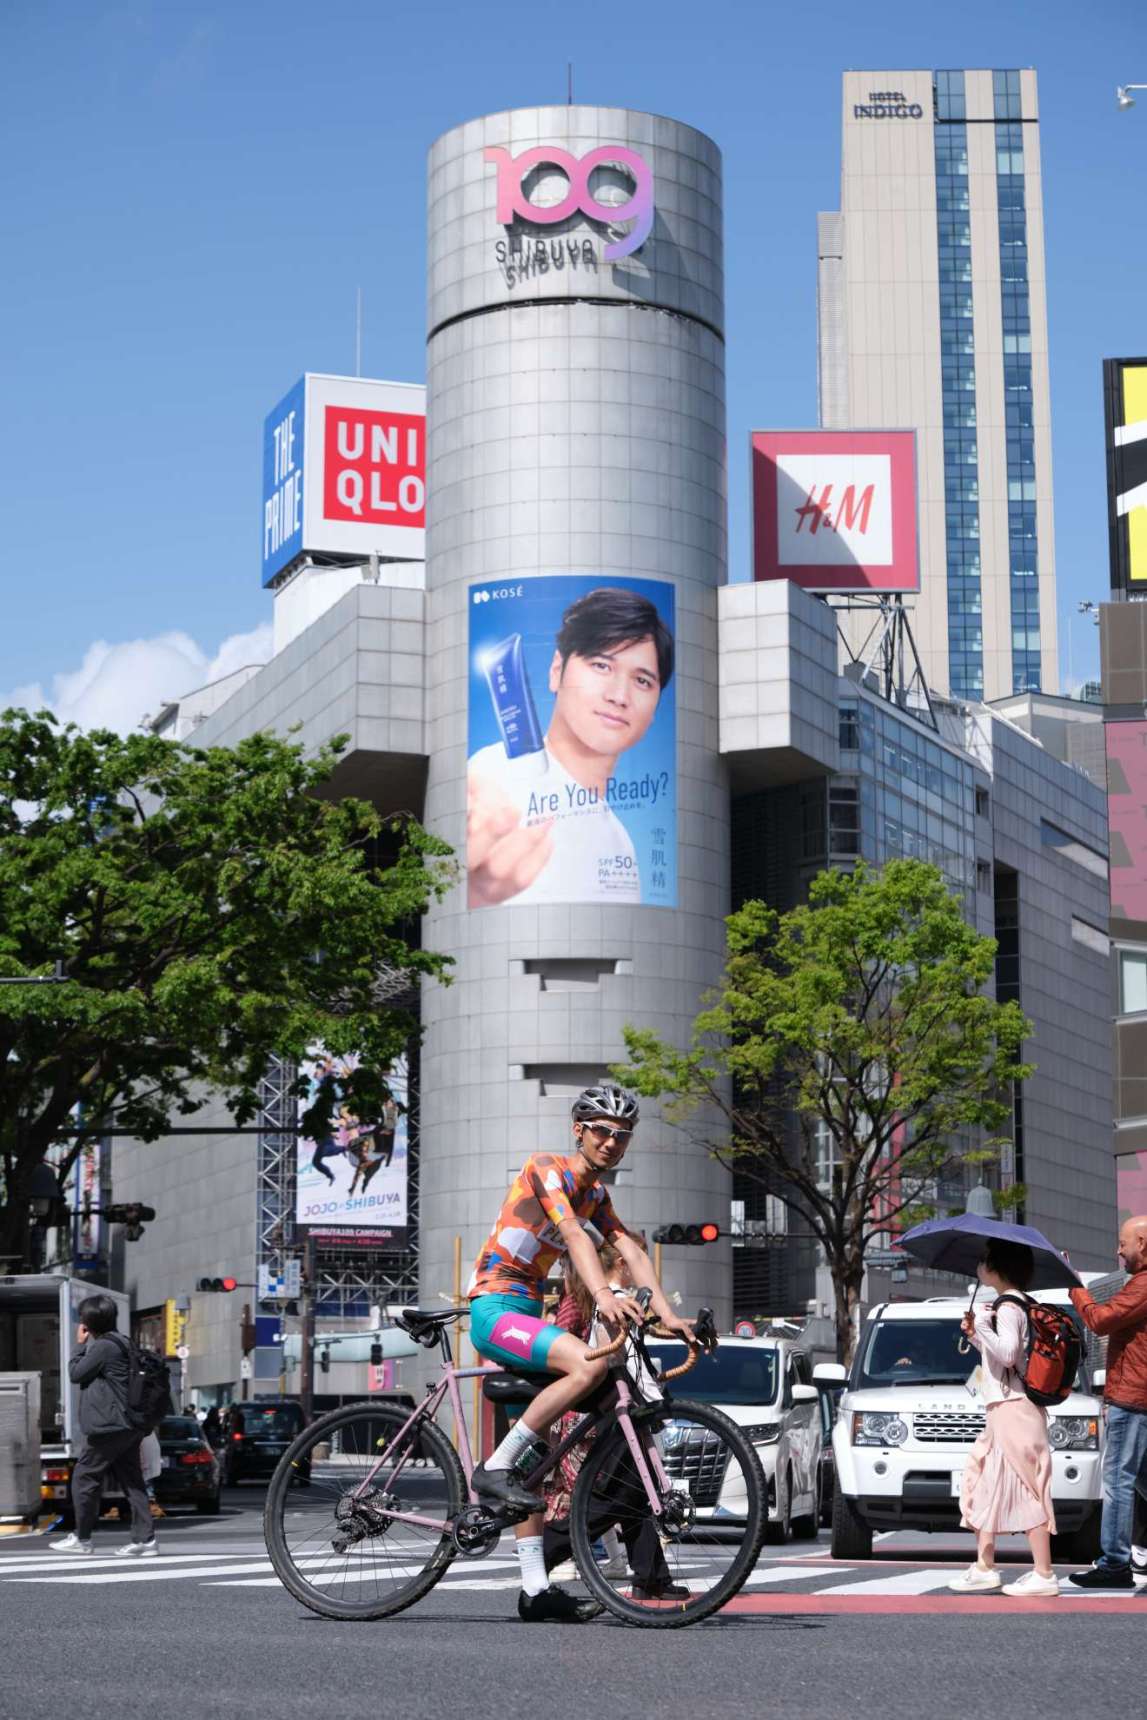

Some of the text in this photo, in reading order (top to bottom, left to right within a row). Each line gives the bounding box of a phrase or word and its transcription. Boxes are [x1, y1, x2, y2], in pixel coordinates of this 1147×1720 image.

[854, 103, 923, 119] INDIGO
[868, 91, 906, 102] HOTEL
[483, 145, 655, 261] 109
[495, 239, 593, 264] SHIBUYA
[274, 410, 296, 486] THE
[337, 421, 417, 467] UNI
[264, 469, 302, 560] PRIME
[336, 469, 426, 515] QLO
[795, 484, 875, 535] H&M
[492, 585, 524, 600] KOSÉ
[527, 792, 559, 817] Are
[565, 784, 598, 809] You
[605, 771, 669, 804] Ready?
[304, 1202, 337, 1217] JOJO
[346, 1192, 401, 1211] SHIBUYA
